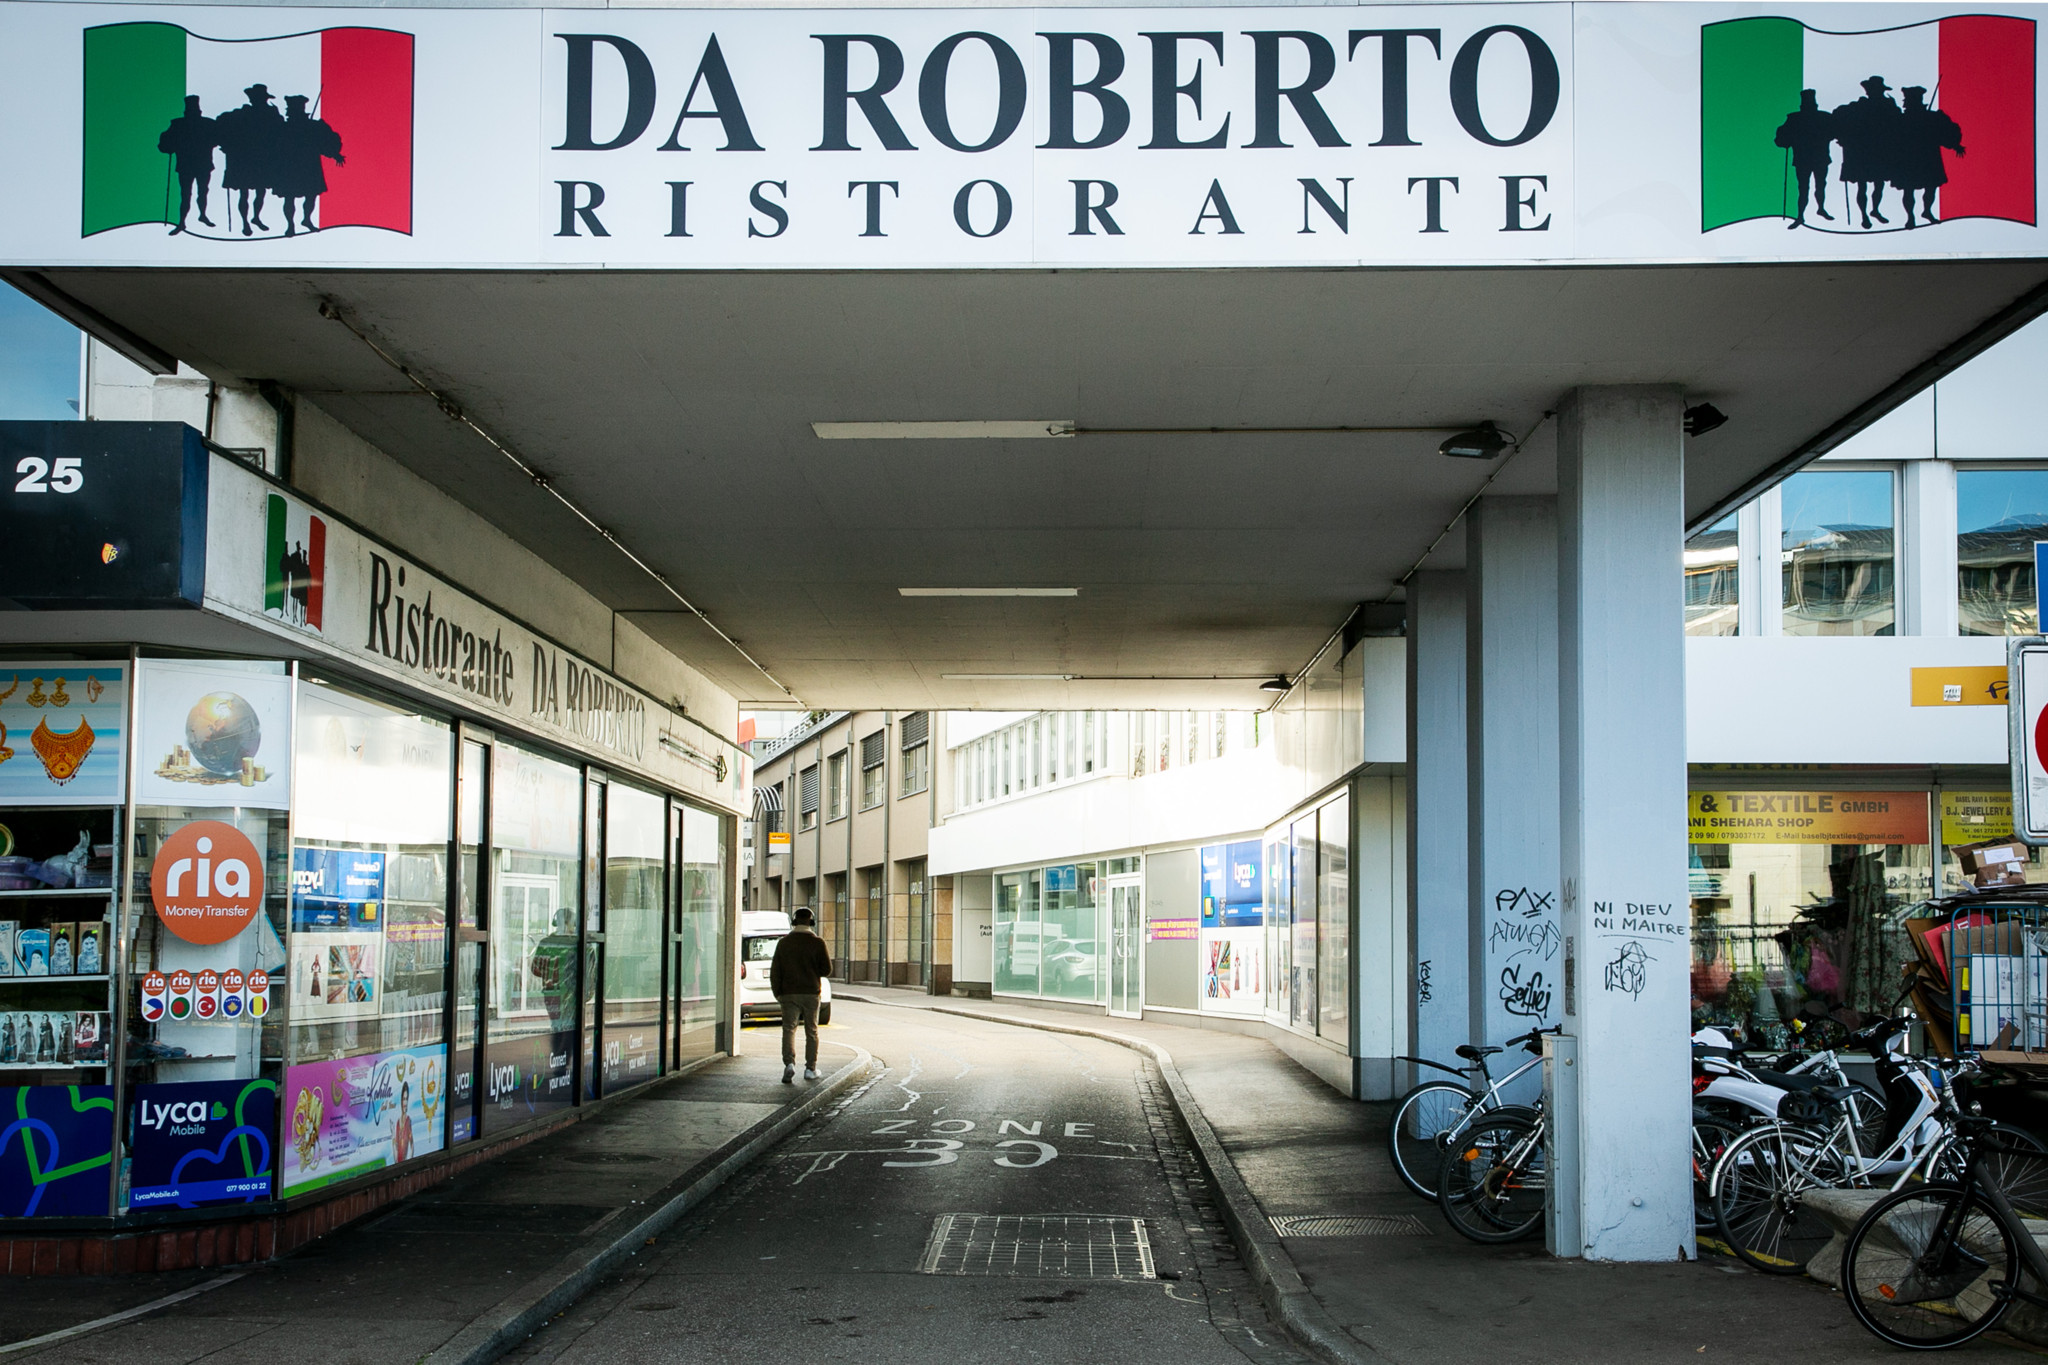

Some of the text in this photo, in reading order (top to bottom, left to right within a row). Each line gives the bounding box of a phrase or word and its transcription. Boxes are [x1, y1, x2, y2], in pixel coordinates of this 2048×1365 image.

[552, 25, 1560, 152] DA ROBERTO
[554, 176, 1552, 237] RISTORANTE
[16, 457, 84, 493] 25
[364, 551, 646, 763] Ristorante DA ROBERTO
[1700, 794, 1889, 813] & TEXTILE GMBH
[1955, 795, 1970, 803] BASEL
[1946, 806, 2012, 816] B.J. JEWELLERY &
[1710, 817, 1773, 828] SHEHARA
[1777, 817, 1814, 828] SHOP
[1801, 832, 1905, 841] baselbjtextiles@gmail.com
[167, 837, 251, 898] ria
[166, 904, 249, 919] Money Transfer
[1594, 901, 1672, 916] NI DIEU
[1594, 918, 1686, 936] NI MAITRE
[145, 974, 165, 988] ria
[172, 972, 191, 986] ria
[198, 972, 217, 985] ria
[224, 972, 242, 985] ria
[249, 972, 267, 985] ria
[549, 1051, 567, 1069] Connect
[489, 1062, 515, 1102] Lyca
[548, 1069, 571, 1095] your world
[500, 1094, 513, 1112] Mobile
[142, 1100, 207, 1130] Lyca
[170, 1124, 206, 1137] Mobile
[872, 1118, 1095, 1138] ZONE
[135, 1190, 179, 1201] LycaMobile.ch
